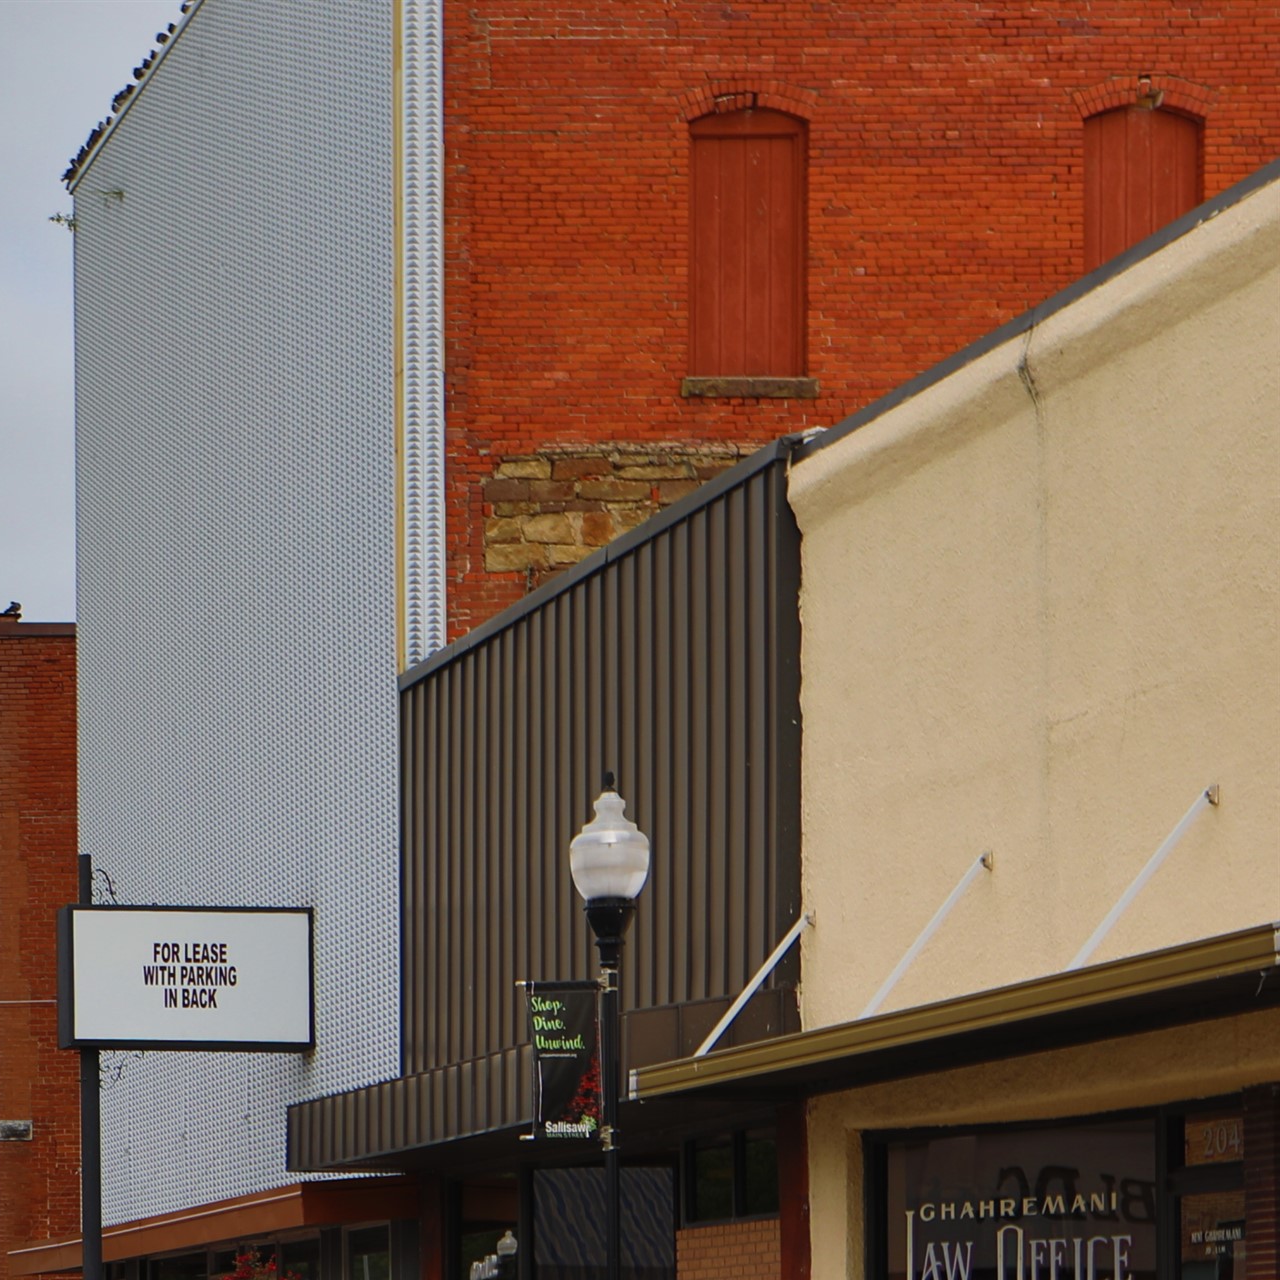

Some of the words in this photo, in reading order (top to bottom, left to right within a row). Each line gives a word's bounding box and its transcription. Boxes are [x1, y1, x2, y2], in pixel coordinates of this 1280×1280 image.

[153, 943, 180, 963] FOR
[184, 943, 227, 963] LEASE
[143, 965, 176, 986] WITH
[180, 966, 237, 986] PARKING
[164, 988, 177, 1008] IN
[182, 988, 218, 1008] BACK
[531, 996, 566, 1016] Shop.
[533, 1015, 566, 1031] Dine.
[535, 1033, 586, 1050] Unwind.
[1203, 1123, 1241, 1155] 204
[919, 1192, 1117, 1222] GHAHREMANI
